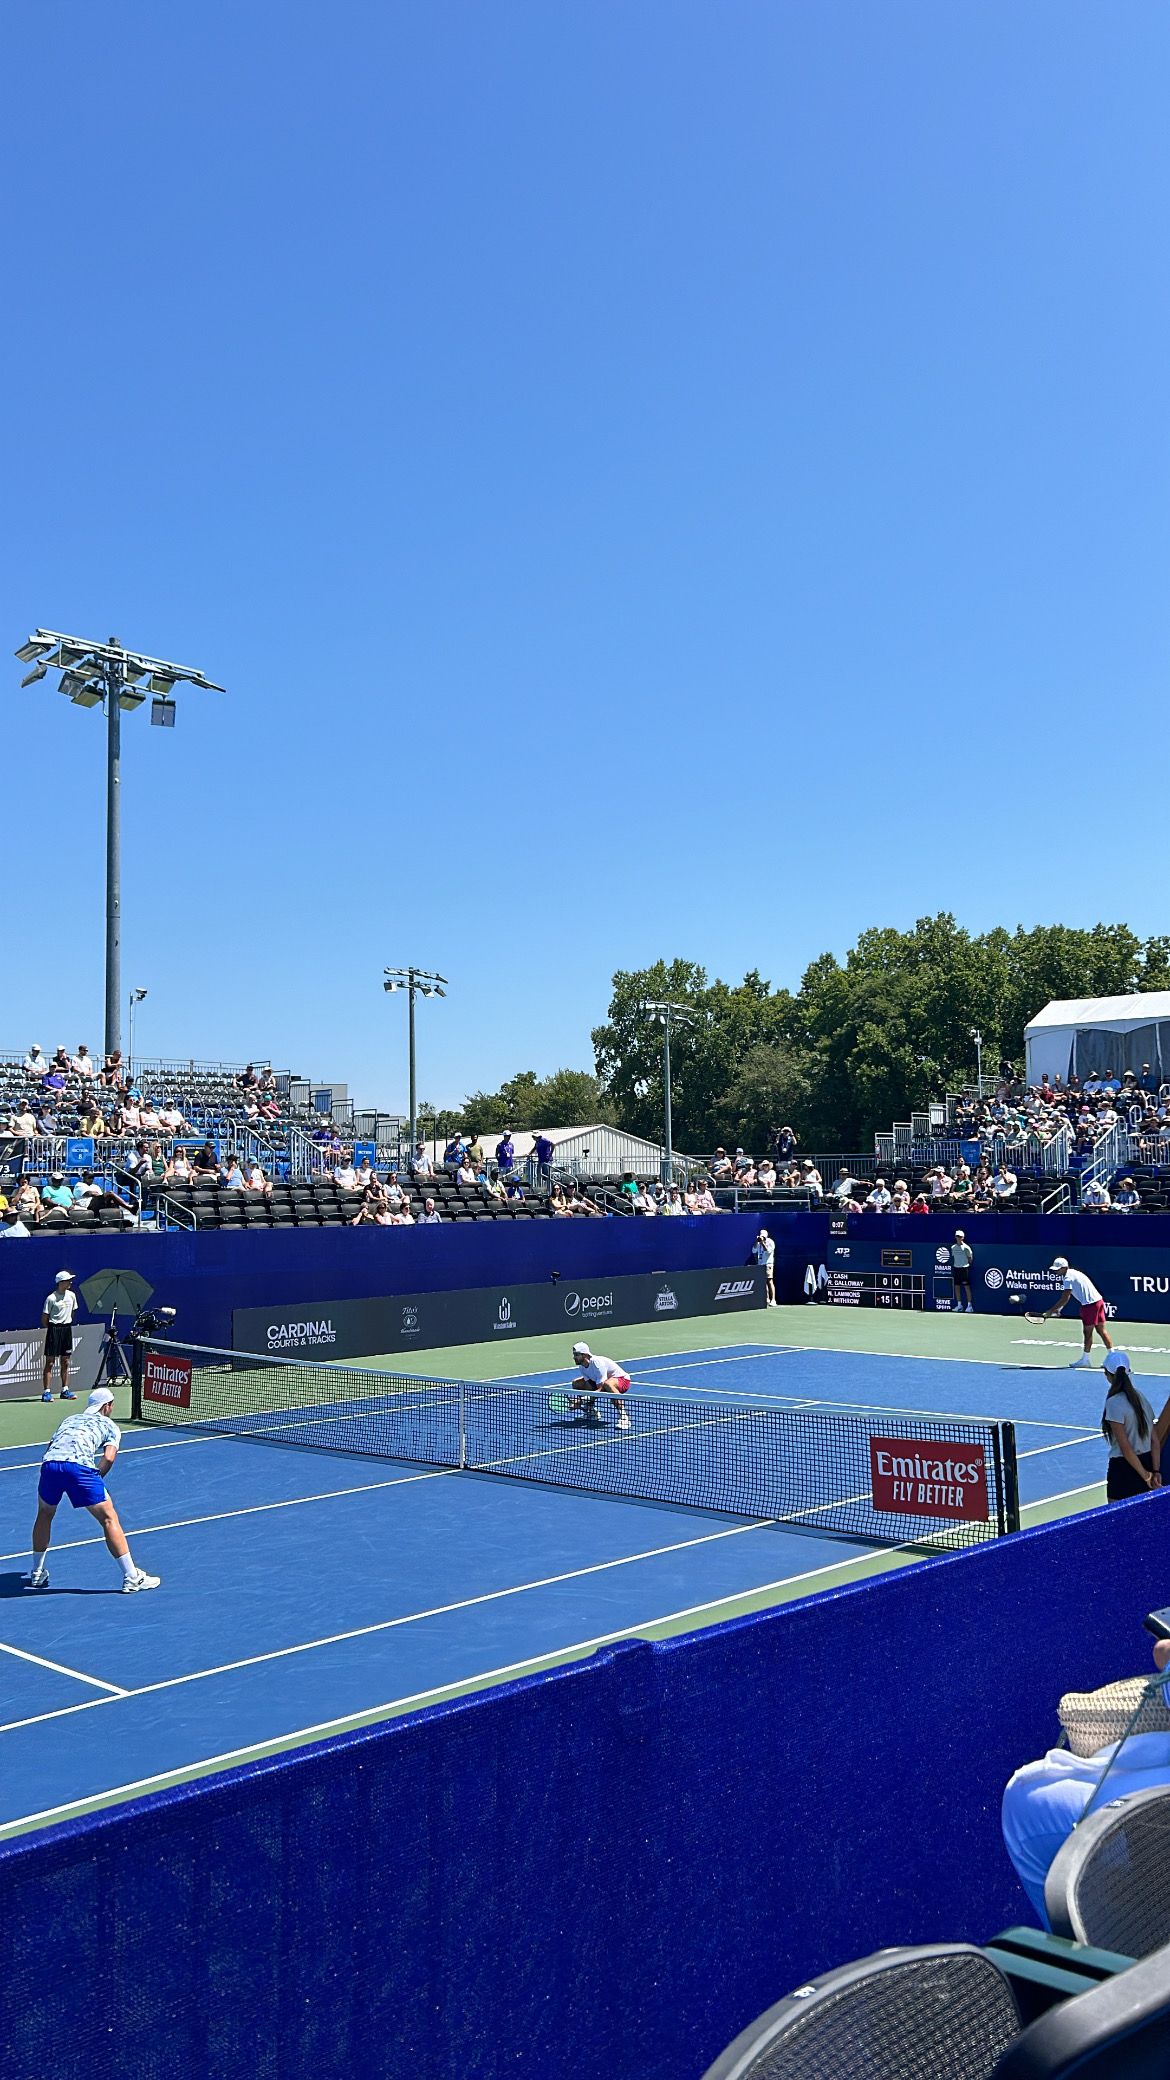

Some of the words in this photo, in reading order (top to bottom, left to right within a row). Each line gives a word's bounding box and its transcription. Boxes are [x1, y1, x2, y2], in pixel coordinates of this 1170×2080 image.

[1006, 1269, 1041, 1281] Atrium
[716, 1280, 755, 1294] FLOW
[1006, 1280, 1028, 1290] Wake
[1029, 1281, 1054, 1291] Forest
[582, 1292, 613, 1312] pepsi
[880, 1295, 890, 1304] 15
[894, 1296, 899, 1304] 1
[267, 1320, 337, 1340] CARDINAL
[267, 1338, 300, 1349] COURTS
[300, 1337, 307, 1346] &
[308, 1334, 336, 1345] TRACKS
[162, 1382, 182, 1399] BETTER
[892, 1480, 914, 1502] FLY
[917, 1483, 964, 1507] BETTER
